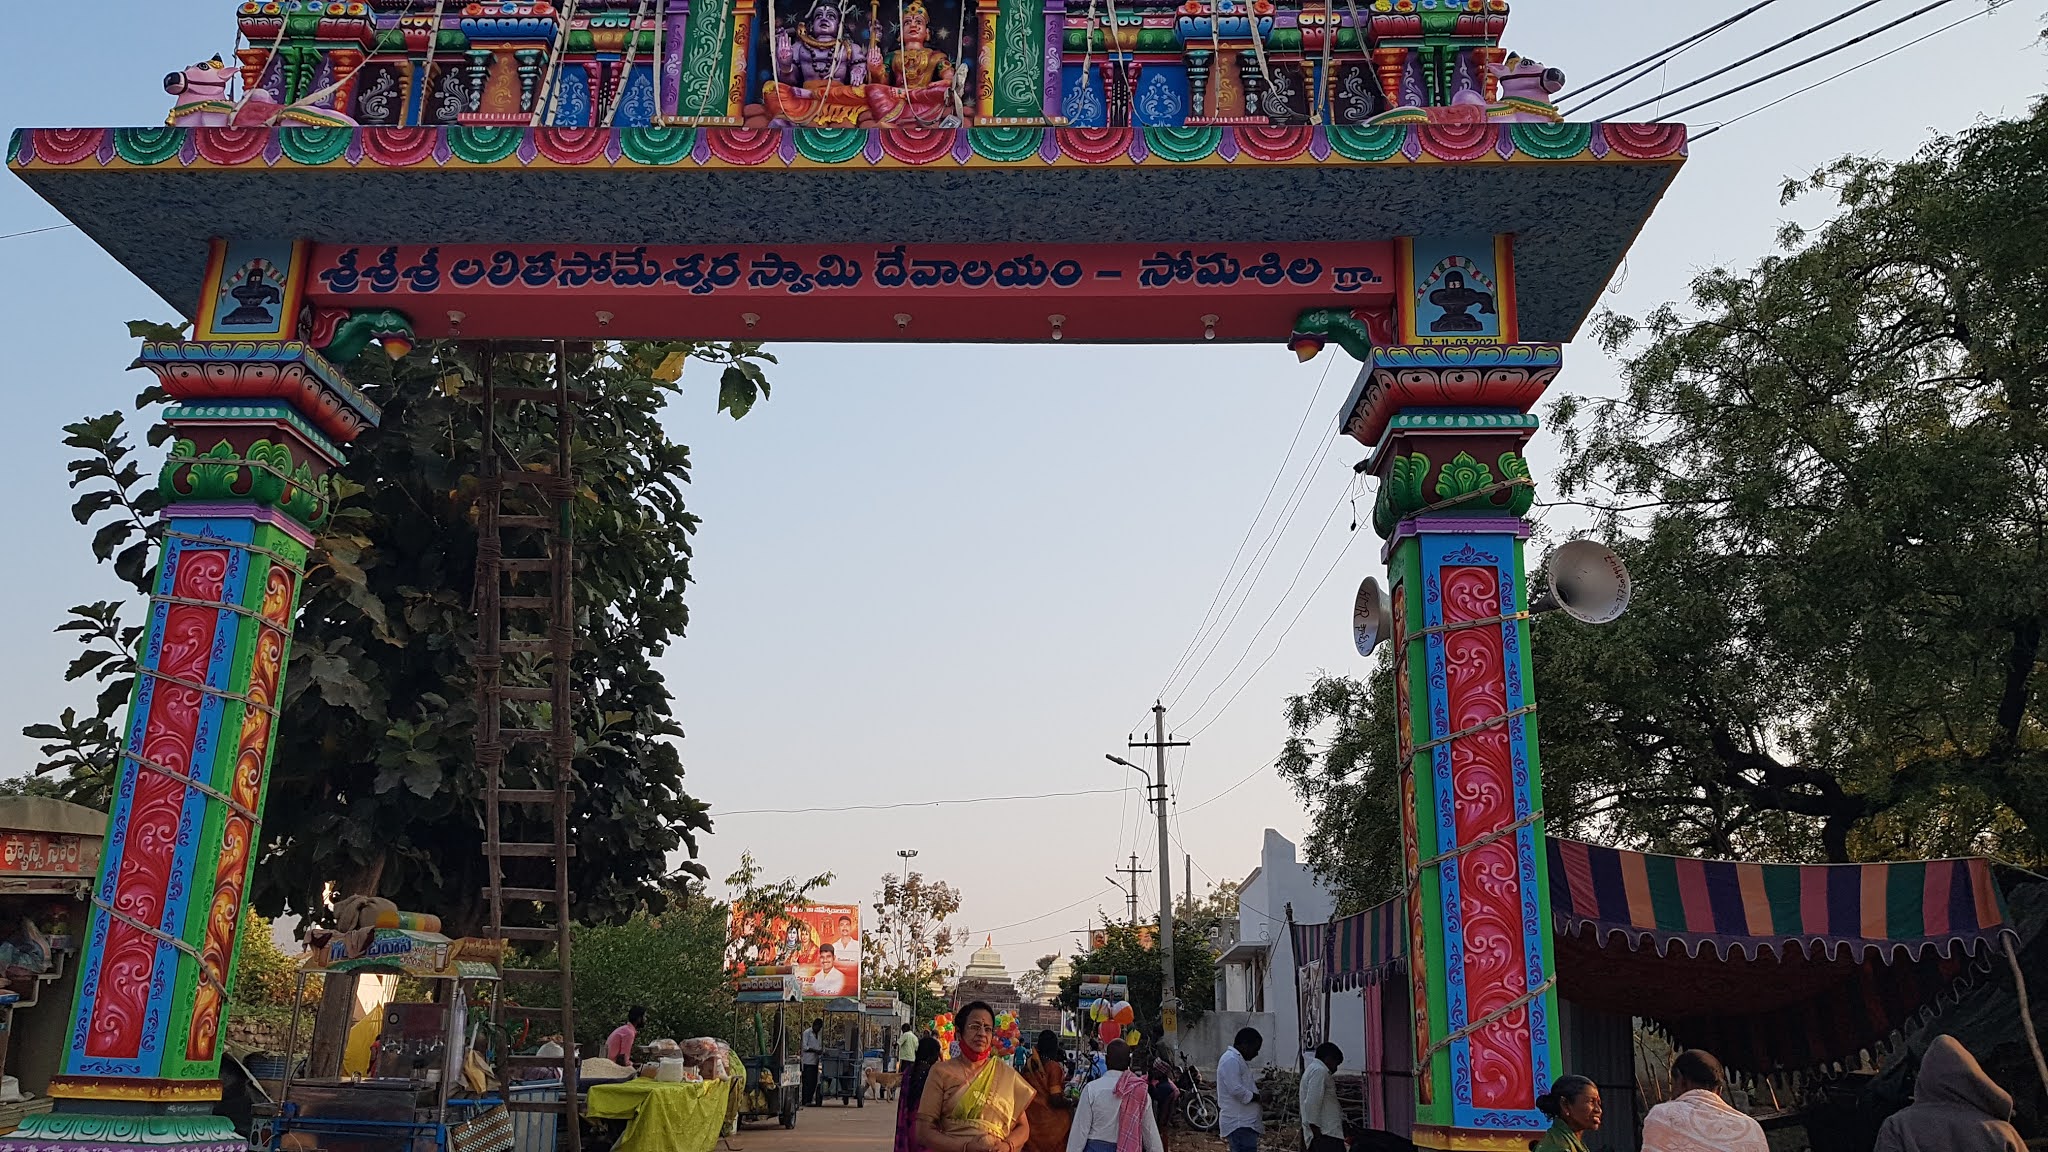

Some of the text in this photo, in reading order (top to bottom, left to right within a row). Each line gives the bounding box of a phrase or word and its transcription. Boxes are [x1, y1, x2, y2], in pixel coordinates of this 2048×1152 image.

[748, 252, 863, 294] స్వామి
[873, 245, 1083, 289] దేవాలయం
[1138, 250, 1323, 289] సోమశిల
